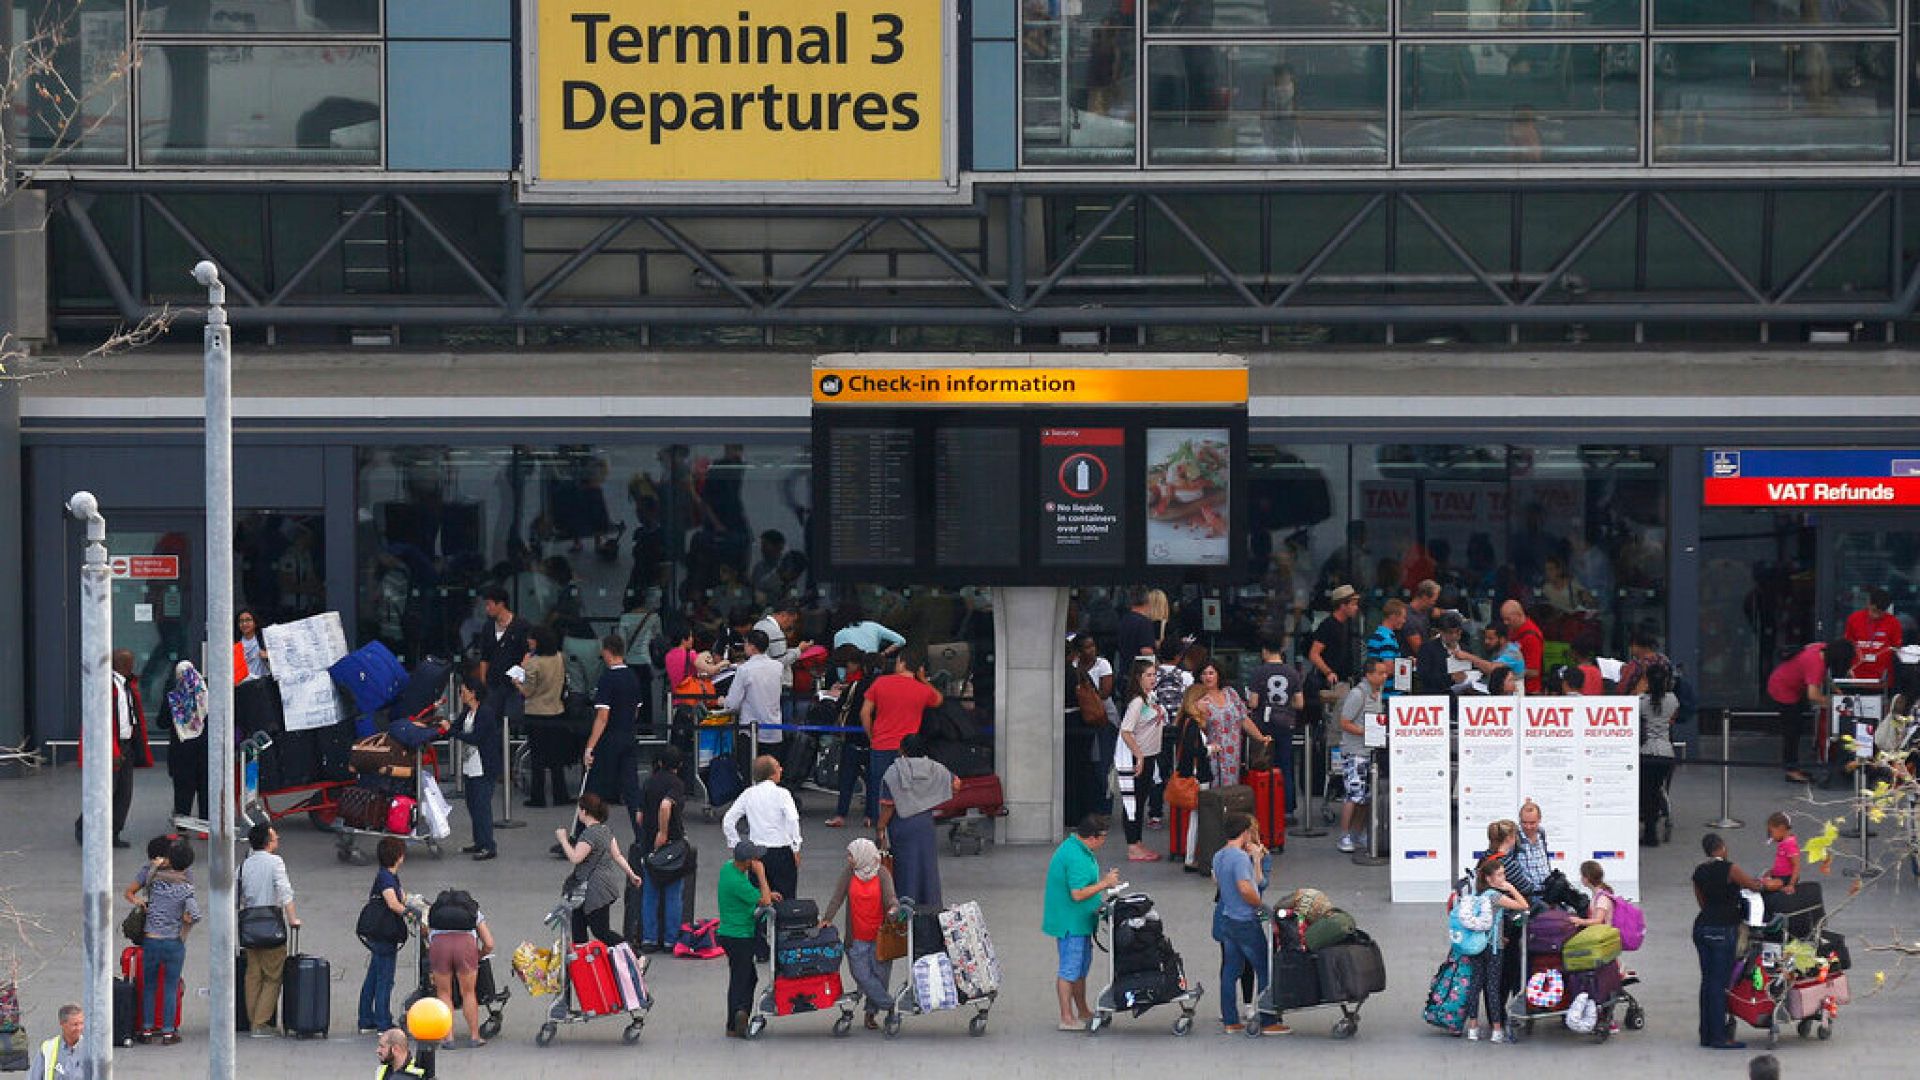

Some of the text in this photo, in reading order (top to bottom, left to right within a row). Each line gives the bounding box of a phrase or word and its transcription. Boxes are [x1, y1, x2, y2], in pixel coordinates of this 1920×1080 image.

[571, 11, 905, 65] Terminal 3
[562, 80, 920, 145] Departures
[849, 375, 1076, 392] Check-in information
[1767, 483, 1896, 501] VAT Refunds
[1057, 503, 1104, 513] No liquids
[1068, 514, 1116, 522] containers
[1081, 524, 1109, 533] 100ml
[1267, 674, 1289, 706] 8
[1396, 706, 1444, 726] VAT
[1465, 706, 1513, 727] VAT
[1526, 707, 1574, 727] VAT
[1586, 706, 1634, 727] VAT
[1394, 728, 1445, 738] REFUNDS
[1464, 728, 1514, 738] REFUNDS
[1525, 728, 1574, 738] REFUNDS
[1584, 728, 1633, 738] REFUNDS
